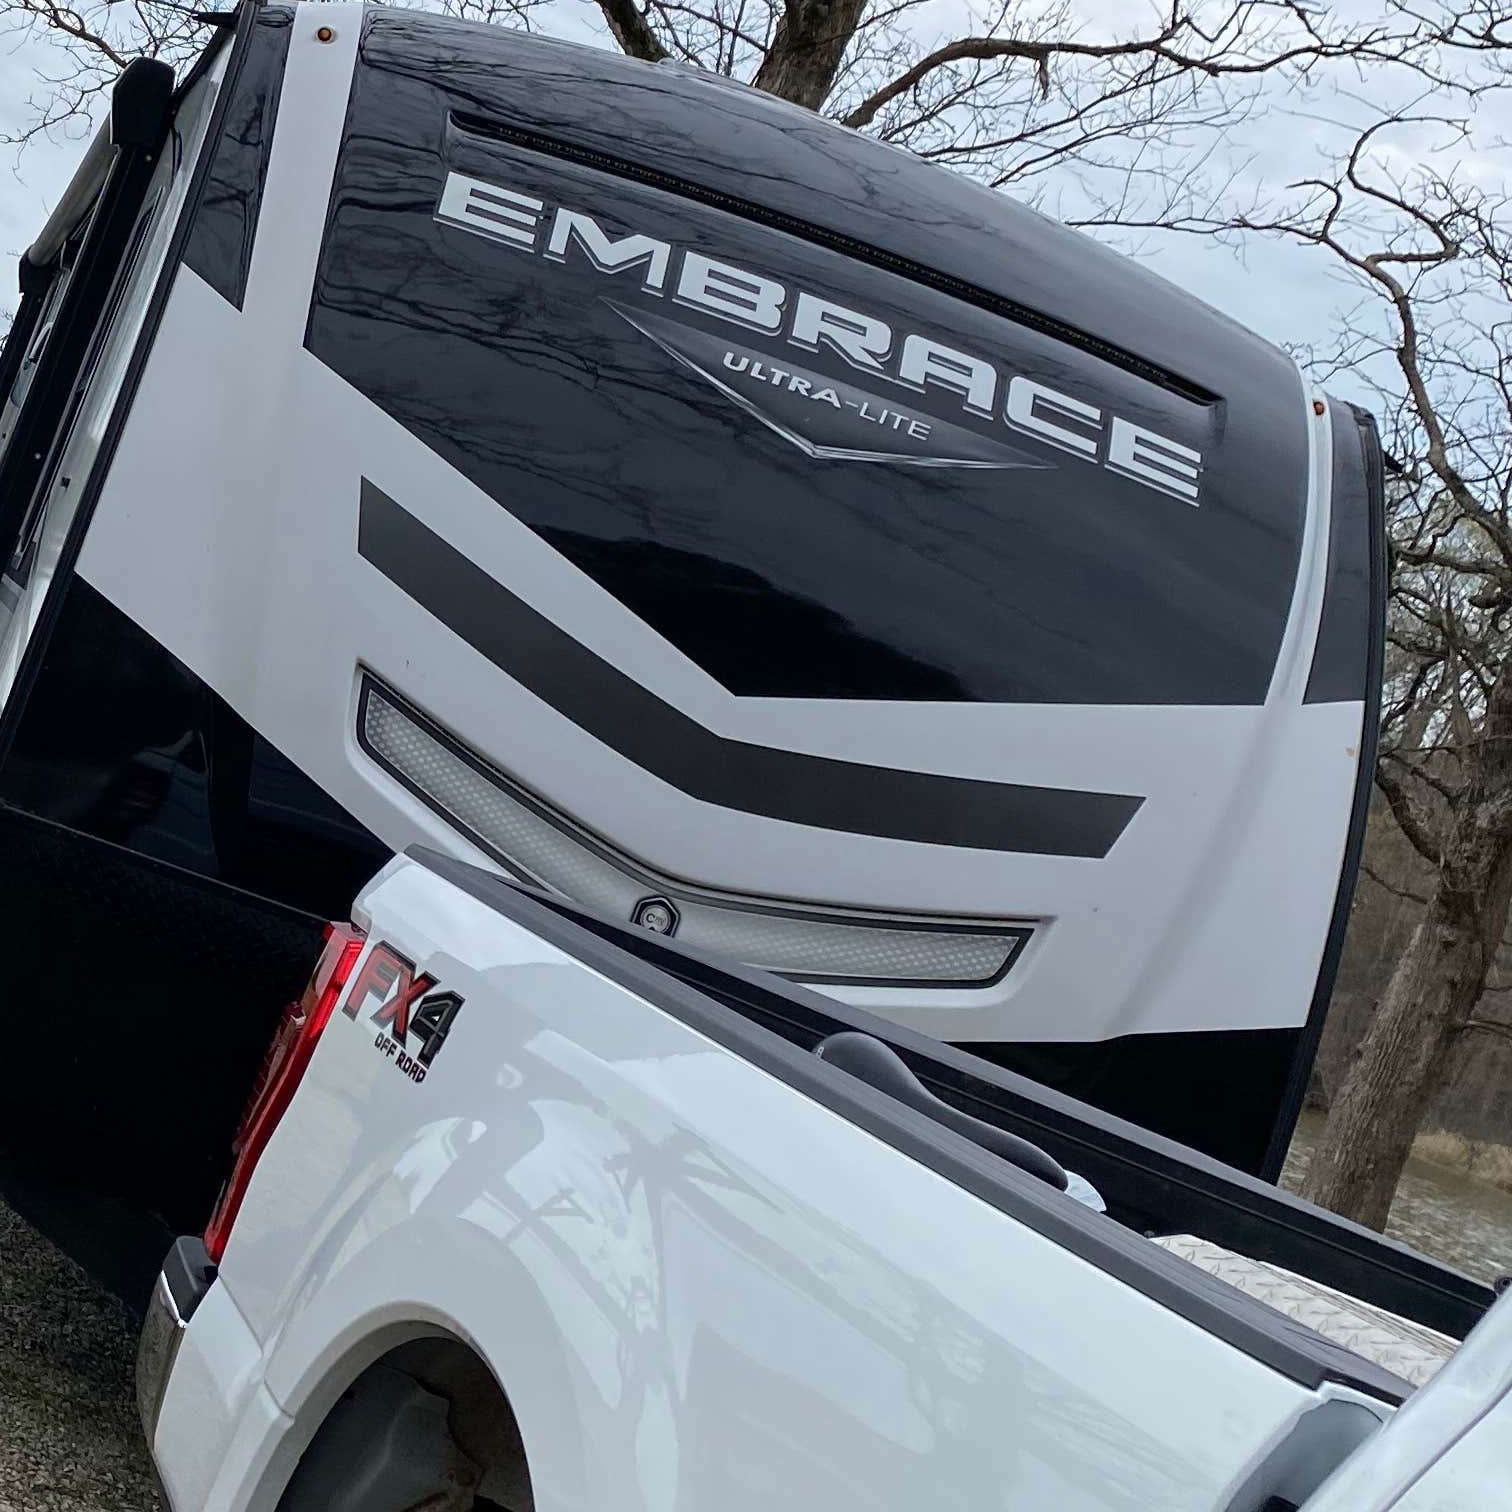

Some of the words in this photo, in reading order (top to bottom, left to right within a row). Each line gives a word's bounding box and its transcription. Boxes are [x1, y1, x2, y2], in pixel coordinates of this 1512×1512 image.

[433, 171, 1204, 507] EMBRACE
[722, 351, 932, 441] ULTRA-LITE
[341, 940, 466, 1069] FX4
[374, 1032, 396, 1057] OFF
[395, 1052, 427, 1083] ROAD
